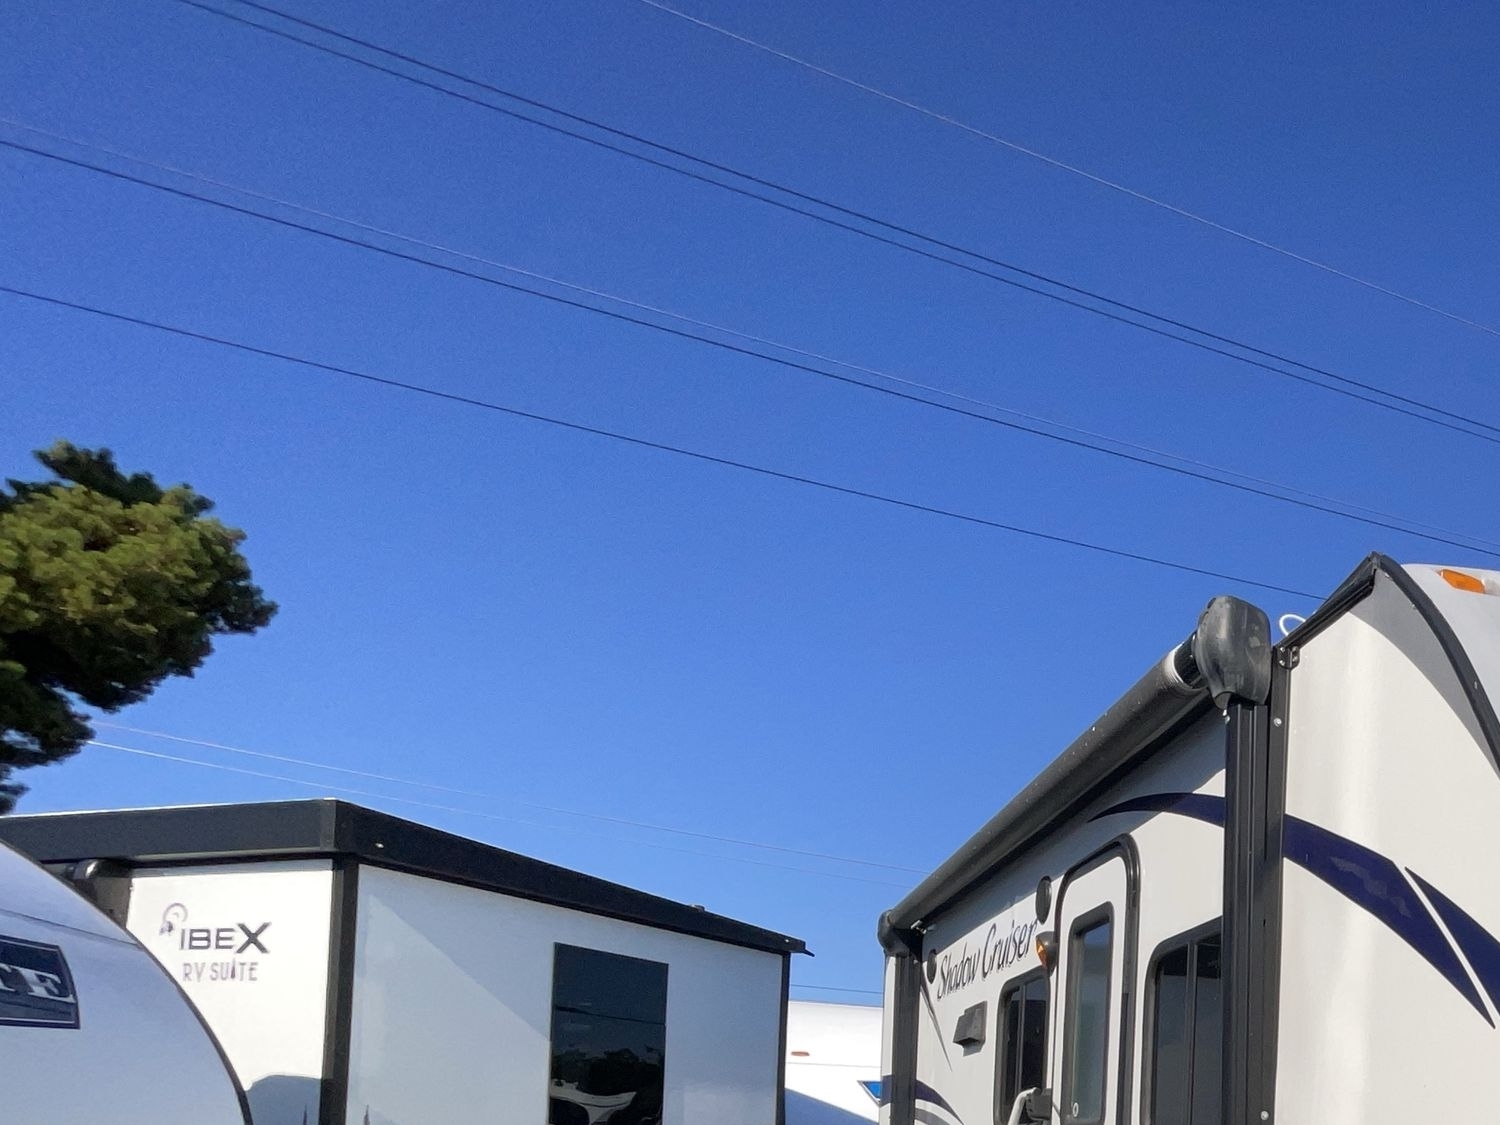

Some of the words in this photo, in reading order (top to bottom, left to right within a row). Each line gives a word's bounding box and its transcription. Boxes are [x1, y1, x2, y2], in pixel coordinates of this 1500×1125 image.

[180, 921, 271, 954] IBEX
[182, 961, 206, 982] RV
[209, 957, 259, 981] SUITE
[937, 941, 981, 1001] Shadow
[982, 918, 1038, 980] Cruiser
